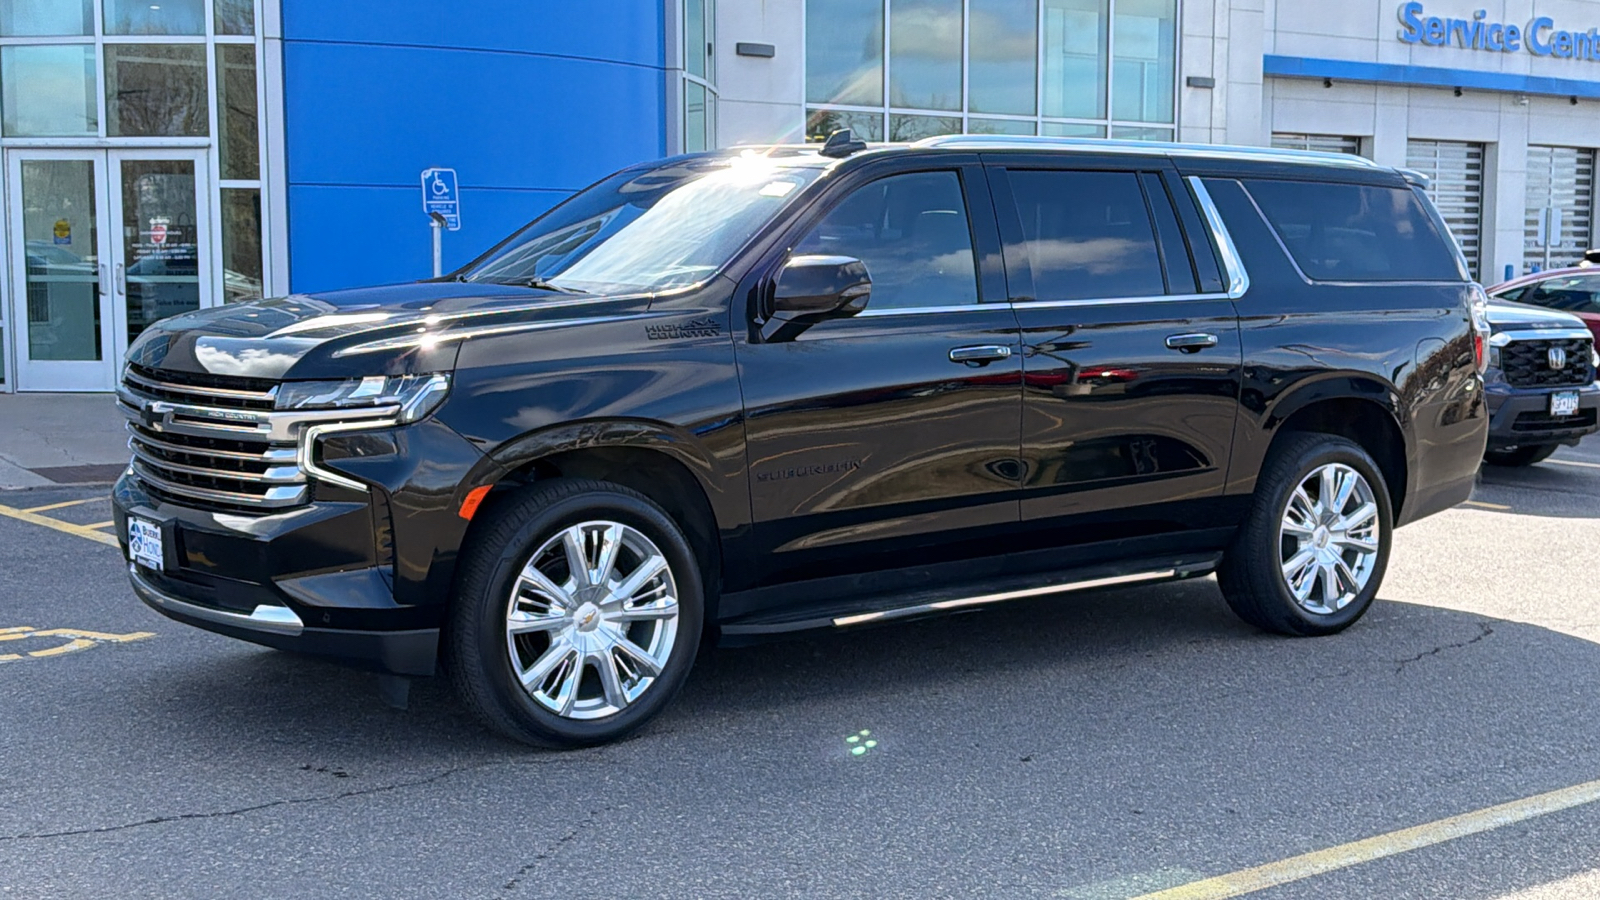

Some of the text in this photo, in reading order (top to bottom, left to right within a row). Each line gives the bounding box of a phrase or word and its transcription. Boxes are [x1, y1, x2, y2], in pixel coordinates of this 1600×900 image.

[1397, 2, 1521, 52] Service
[644, 323, 682, 333] HIGH
[647, 329, 720, 341] COUNTRY
[225, 412, 256, 420] COUNTRY
[756, 460, 861, 481] SUBURBAN
